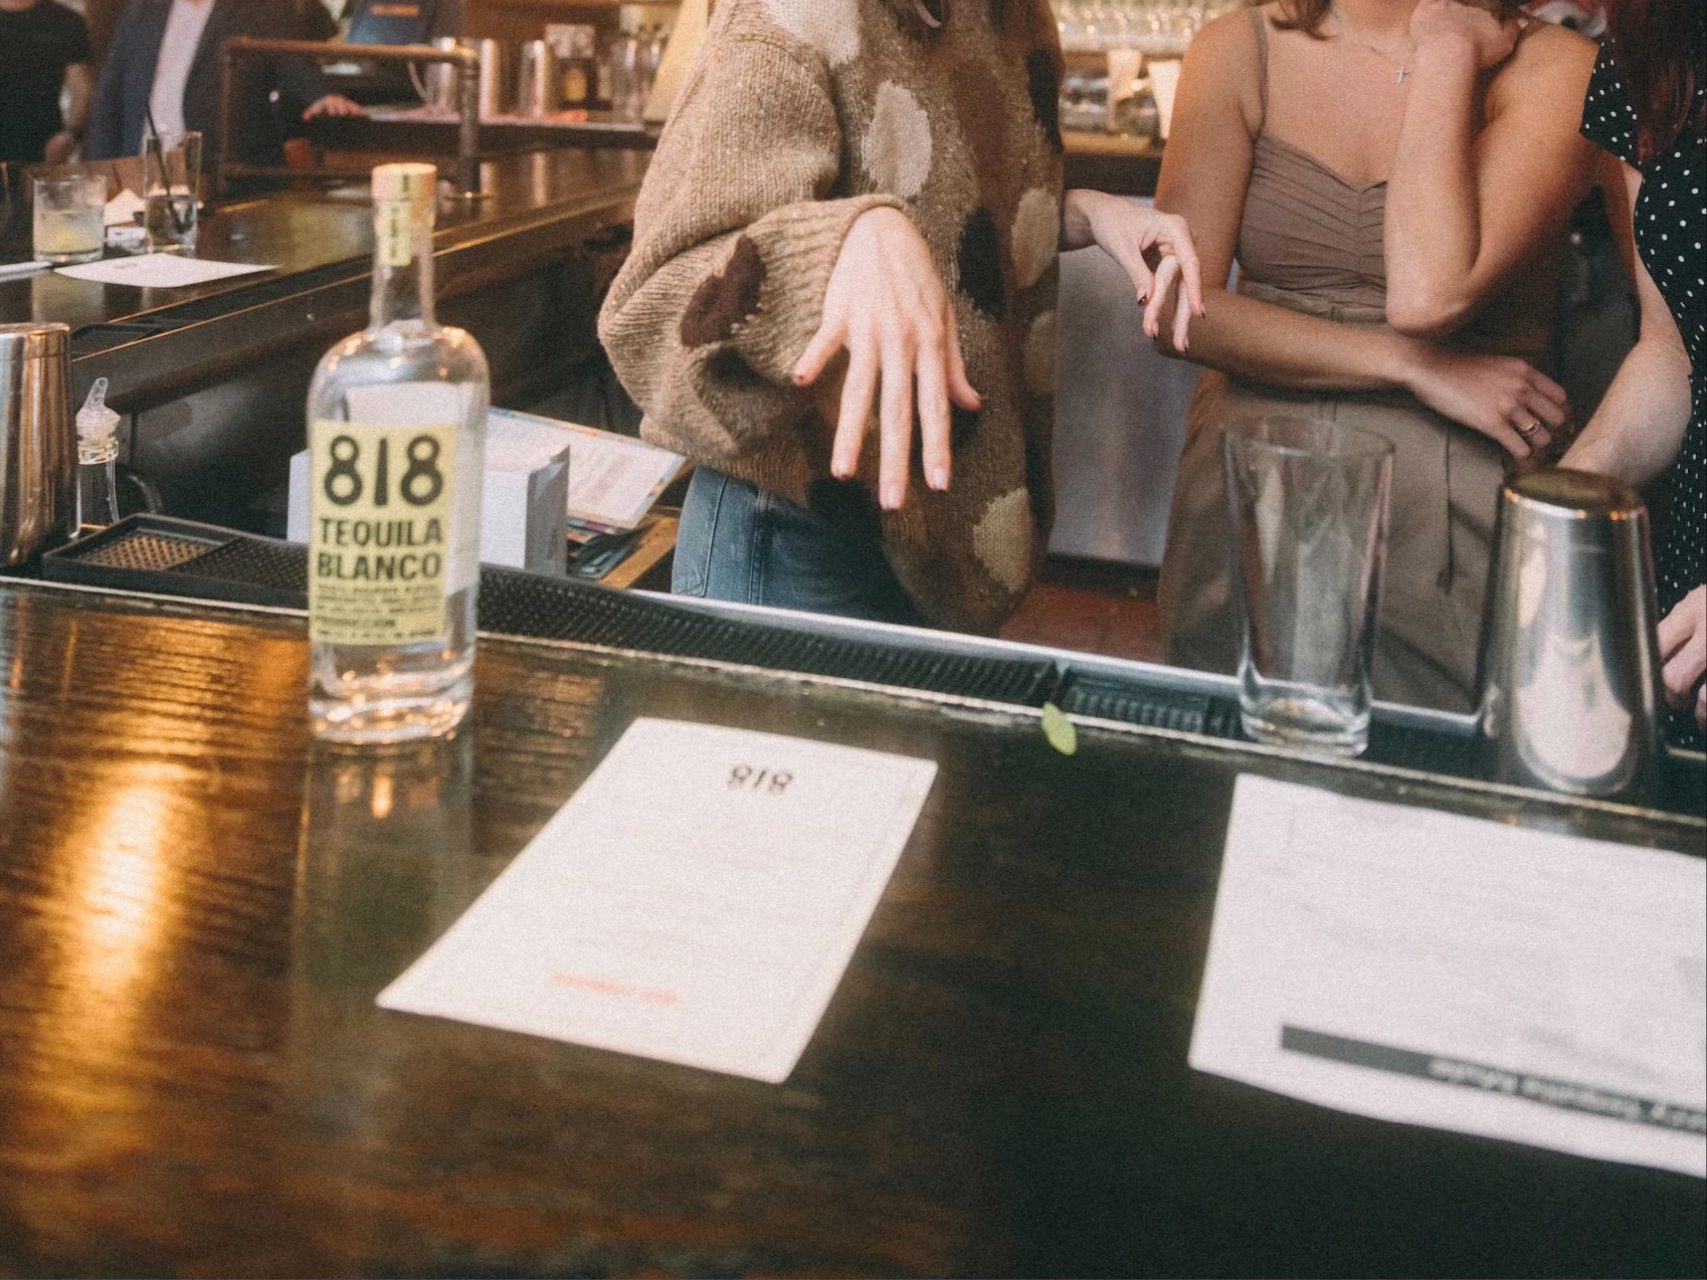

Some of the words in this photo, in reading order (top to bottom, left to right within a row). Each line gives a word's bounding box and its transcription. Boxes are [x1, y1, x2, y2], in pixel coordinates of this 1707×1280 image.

[324, 435, 443, 506] 818
[320, 518, 442, 547] TEQUILA
[317, 552, 441, 581] BLANCO
[727, 765, 793, 795] 818
